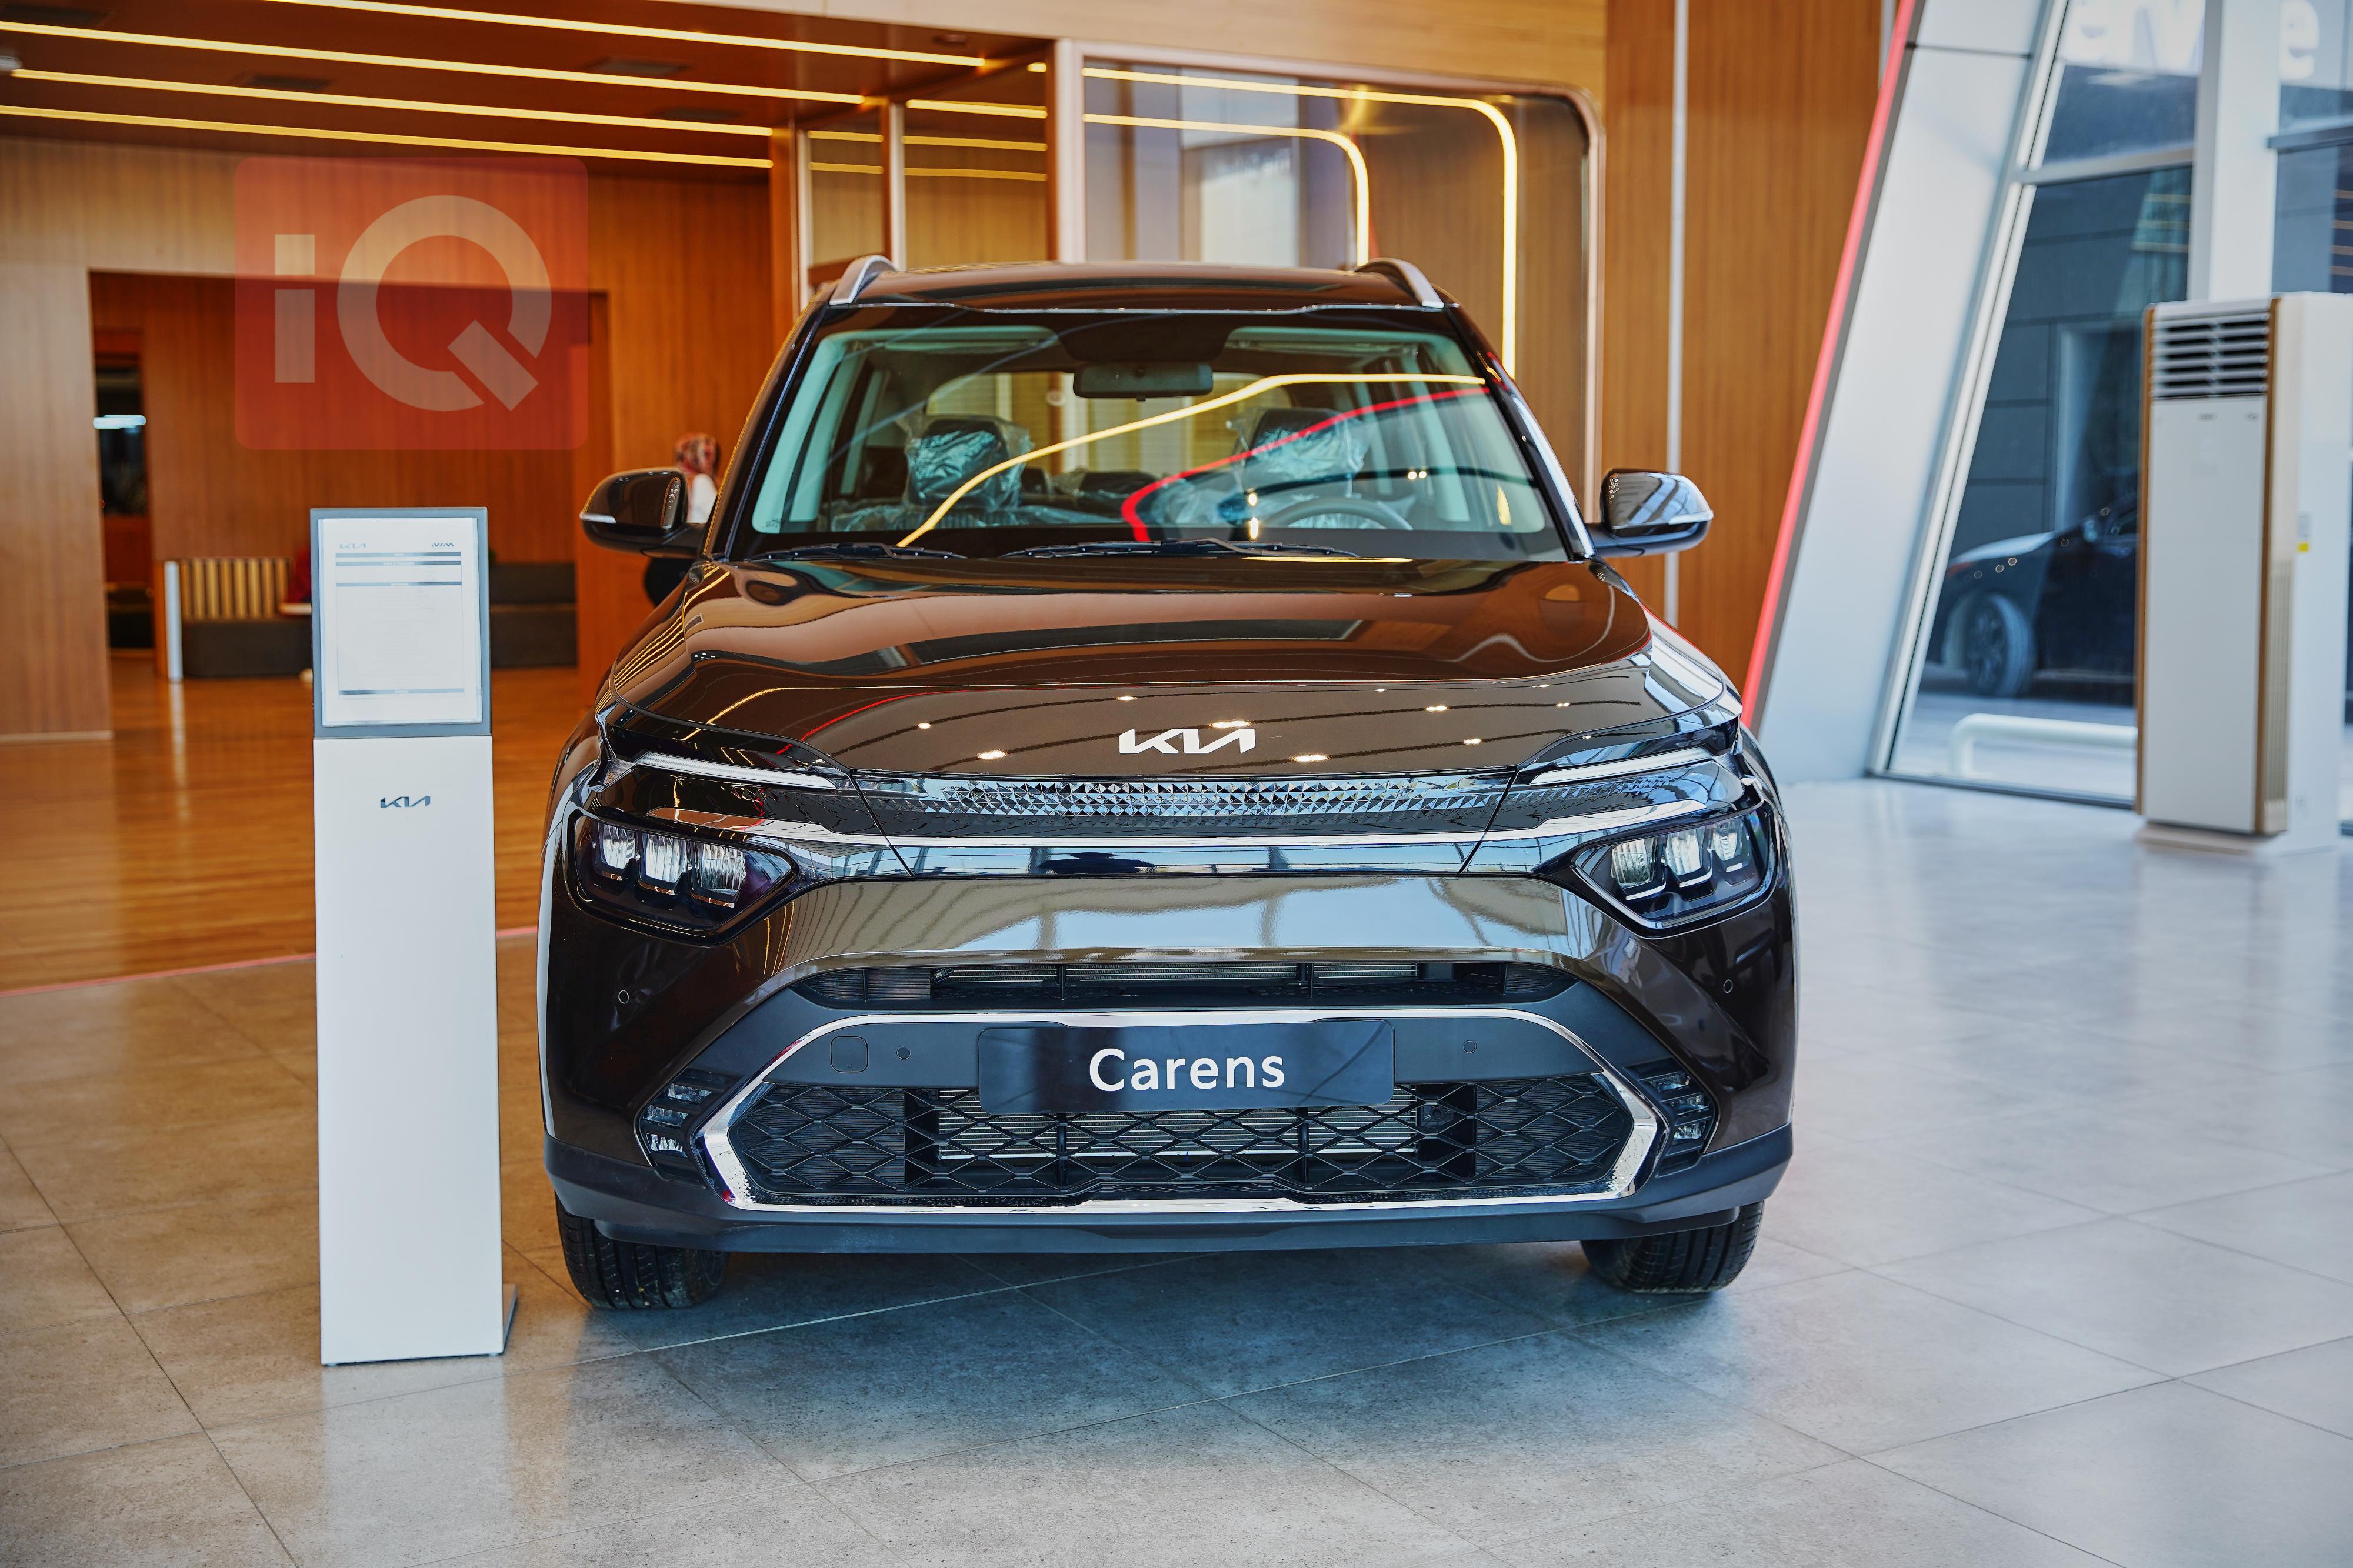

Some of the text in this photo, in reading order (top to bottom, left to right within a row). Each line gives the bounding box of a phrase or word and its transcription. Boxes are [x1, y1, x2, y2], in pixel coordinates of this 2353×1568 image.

[1119, 728, 1256, 754] KIA
[380, 796, 431, 808] KIA
[1089, 1048, 1285, 1092] Carens
